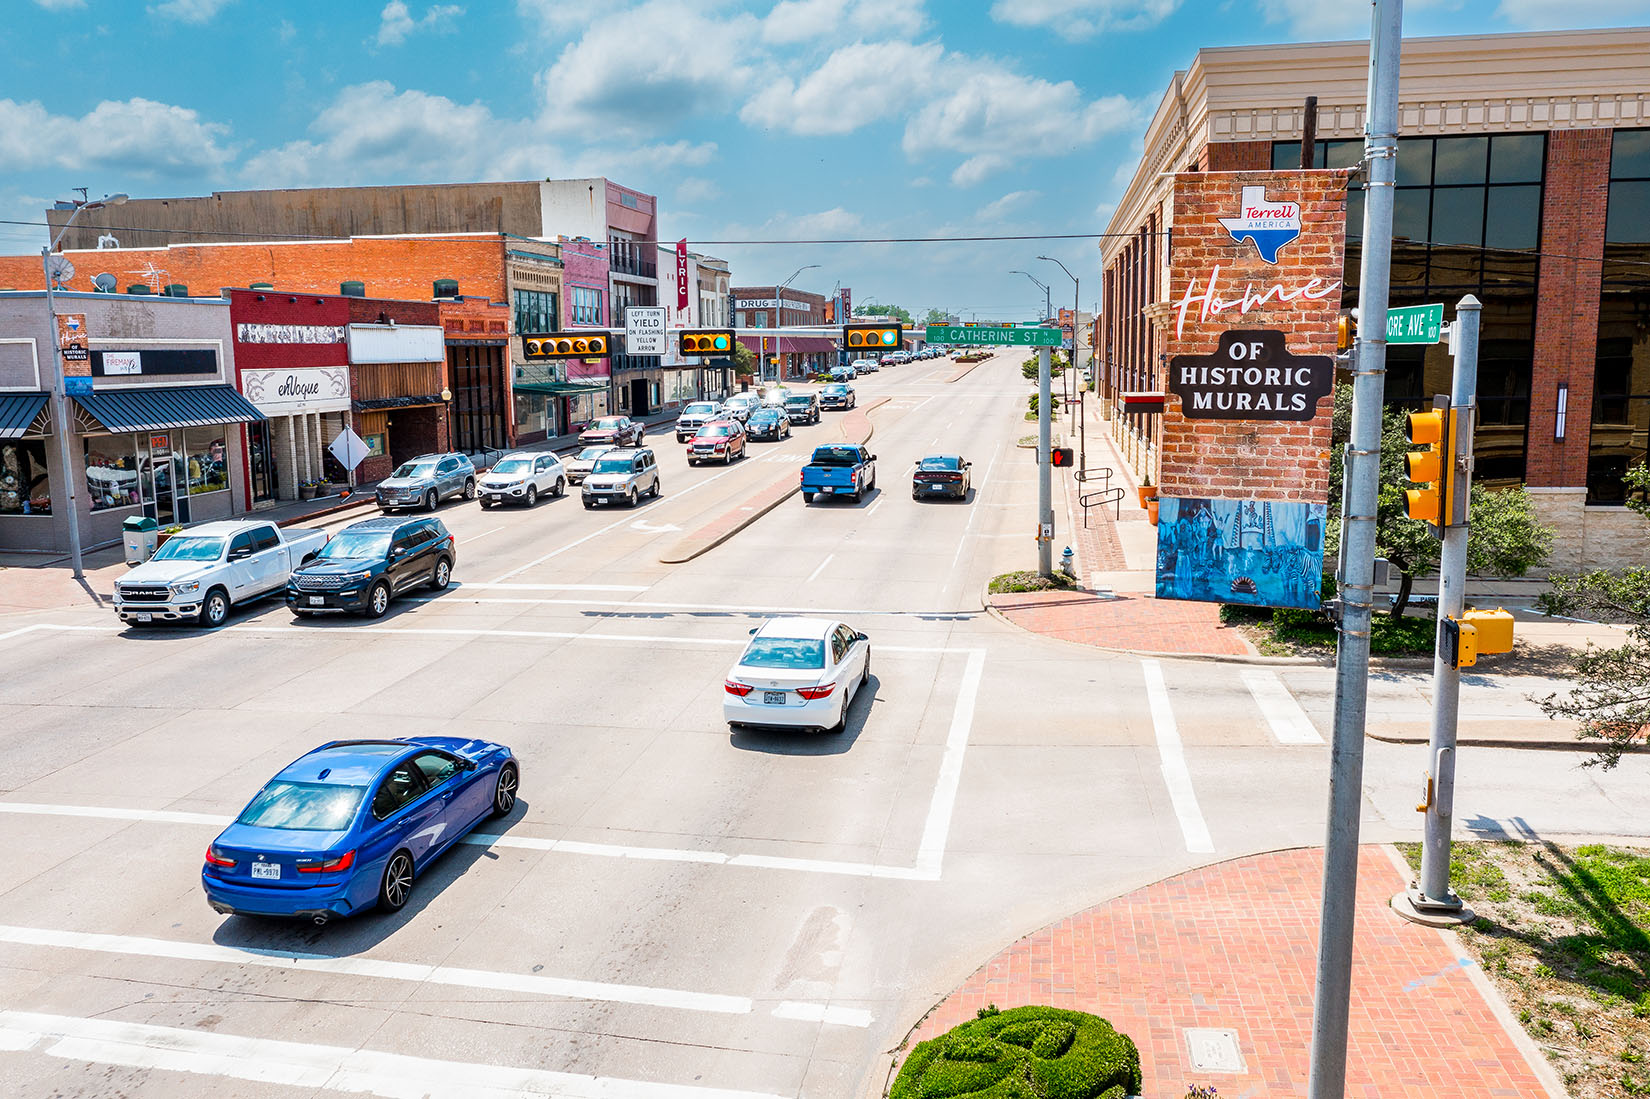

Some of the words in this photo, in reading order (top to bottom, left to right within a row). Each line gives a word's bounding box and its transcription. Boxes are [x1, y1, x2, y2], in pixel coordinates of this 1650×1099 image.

[1245, 206, 1296, 220] Terrell
[1247, 220, 1292, 229] AMERICA
[678, 249, 686, 295] LYRIC
[741, 300, 769, 308] DRUG
[1172, 264, 1342, 341] Home
[1429, 309, 1434, 322] E
[633, 319, 660, 327] YIELD
[1407, 313, 1426, 336] AVE
[61, 331, 88, 344] Home
[950, 329, 1016, 342] CATHERINE
[1023, 331, 1038, 342] ST
[1427, 326, 1437, 339] 100
[1229, 342, 1264, 361] OF
[1180, 367, 1312, 386] HISTORIC
[1192, 392, 1307, 412] MURALS
